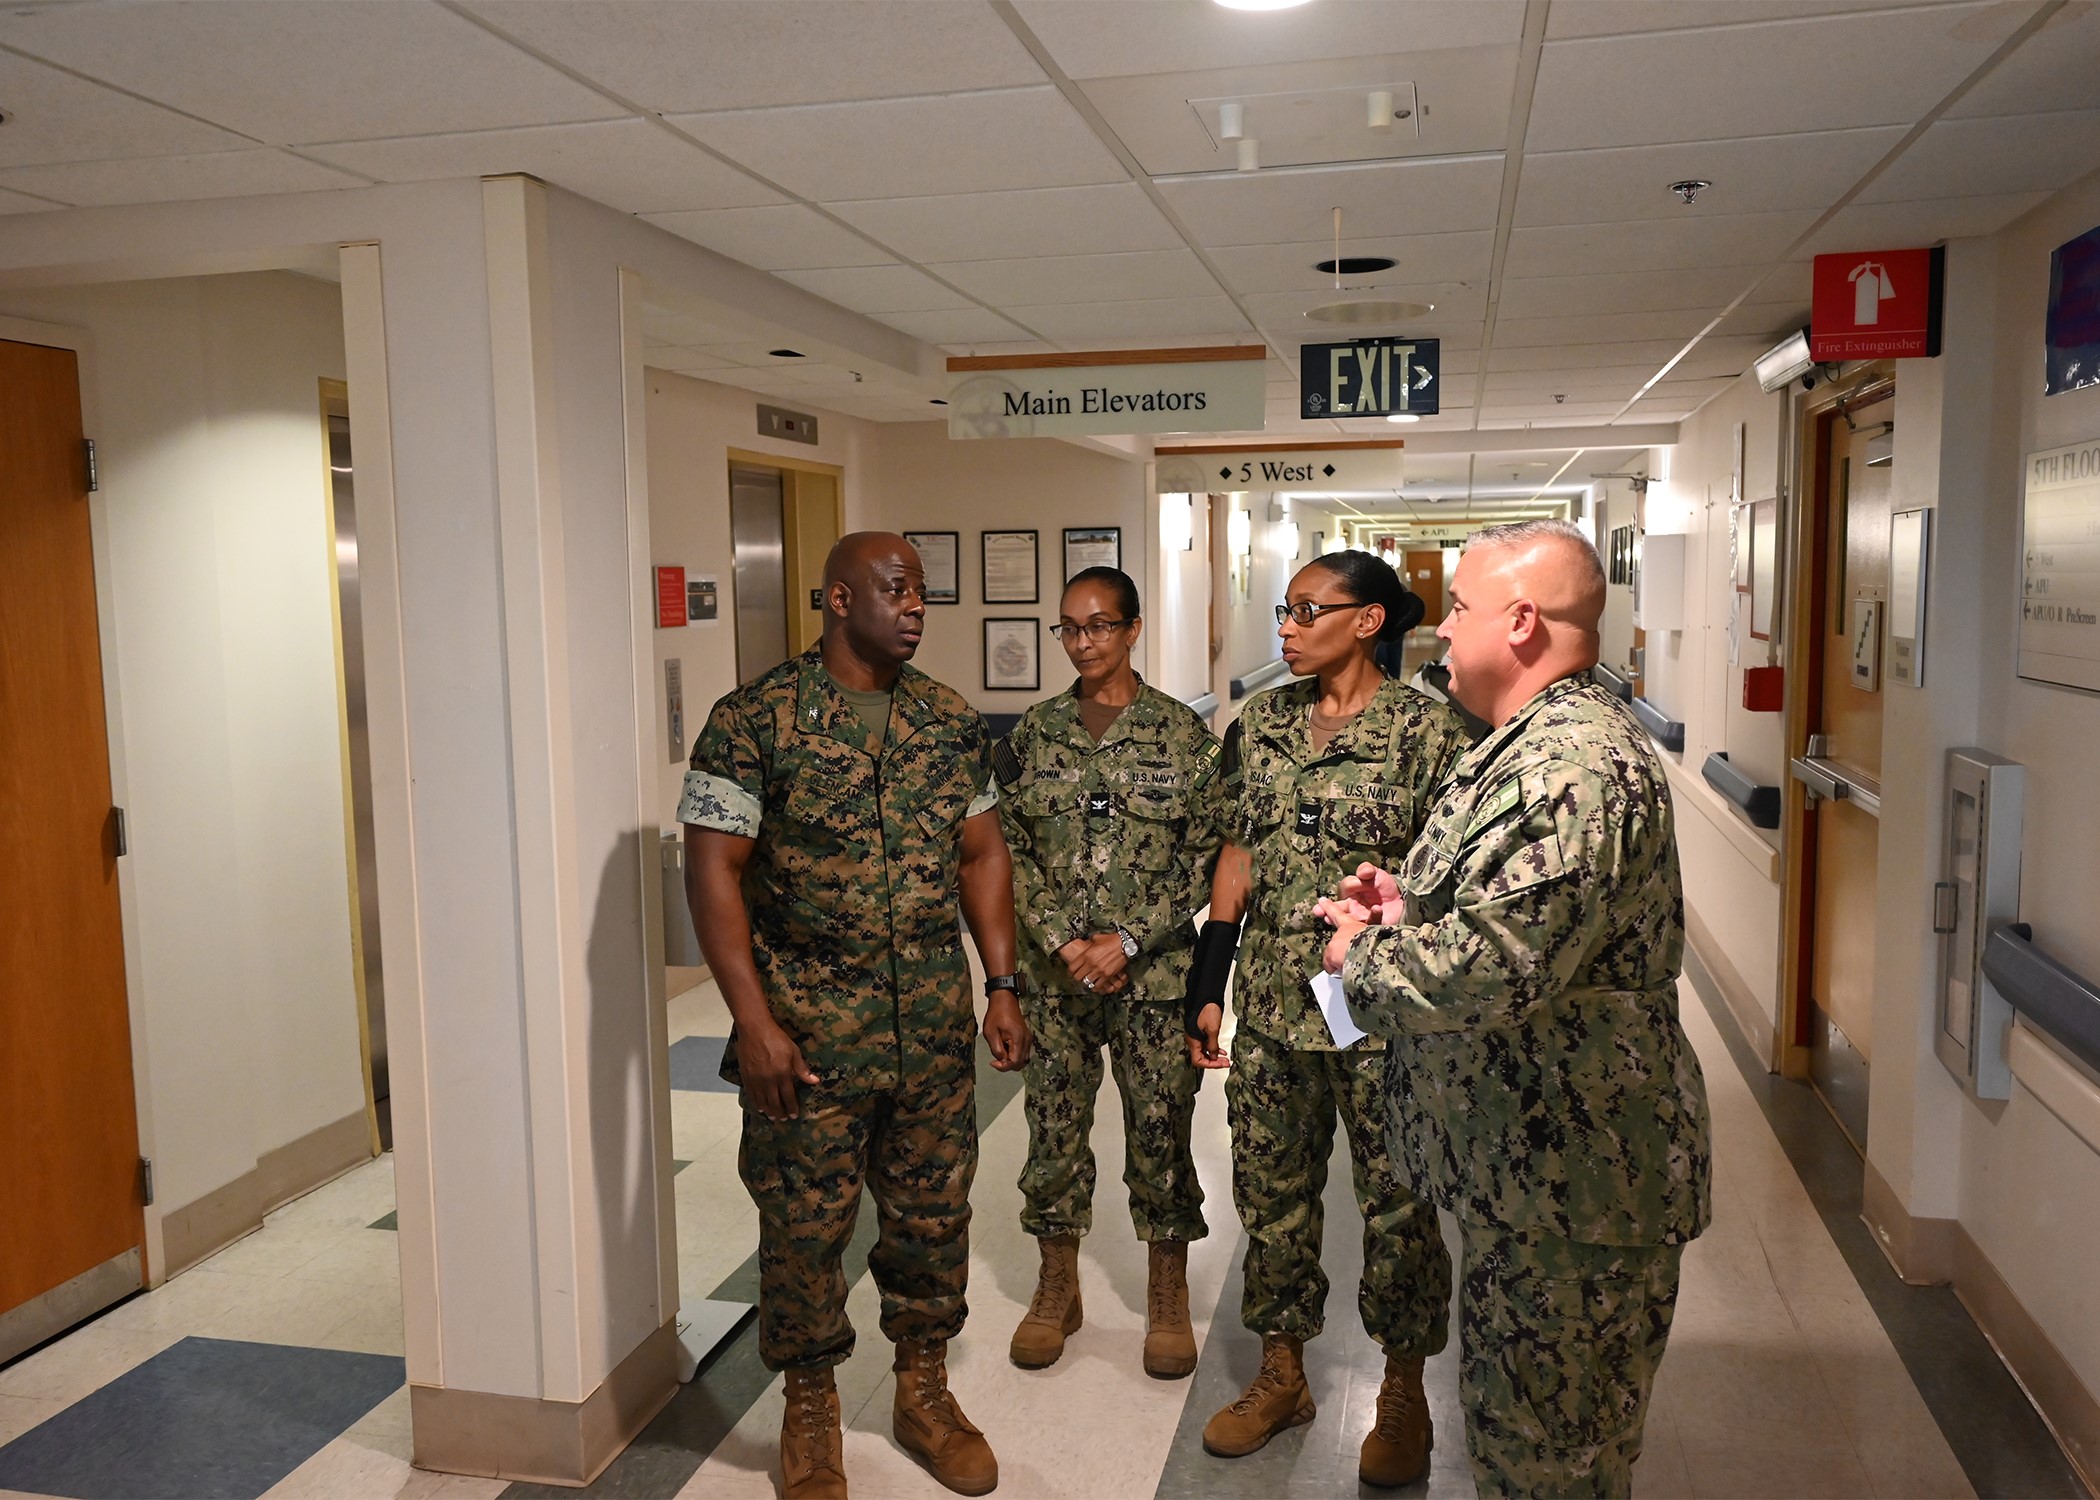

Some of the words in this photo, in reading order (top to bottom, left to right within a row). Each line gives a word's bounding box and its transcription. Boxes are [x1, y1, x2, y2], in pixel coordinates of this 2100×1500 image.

[1817, 341, 1841, 353] Fire
[1845, 338, 1922, 354] Extinguisher
[1330, 345, 1416, 413] EXIT
[1003, 389, 1071, 416] Main
[1080, 388, 1207, 414] Elevators
[1240, 462, 1252, 483] 5
[1260, 461, 1314, 482] West
[2034, 456, 2058, 485] 5TH
[1431, 528, 1449, 536] APU
[2035, 578, 2049, 594] APU
[814, 591, 822, 606] 5
[1132, 772, 1150, 783] U.S.
[1152, 773, 1176, 785] NAVY
[810, 773, 866, 804] GLENCAMP
[1345, 784, 1365, 799] U.S.
[1367, 785, 1398, 802] NAVY
